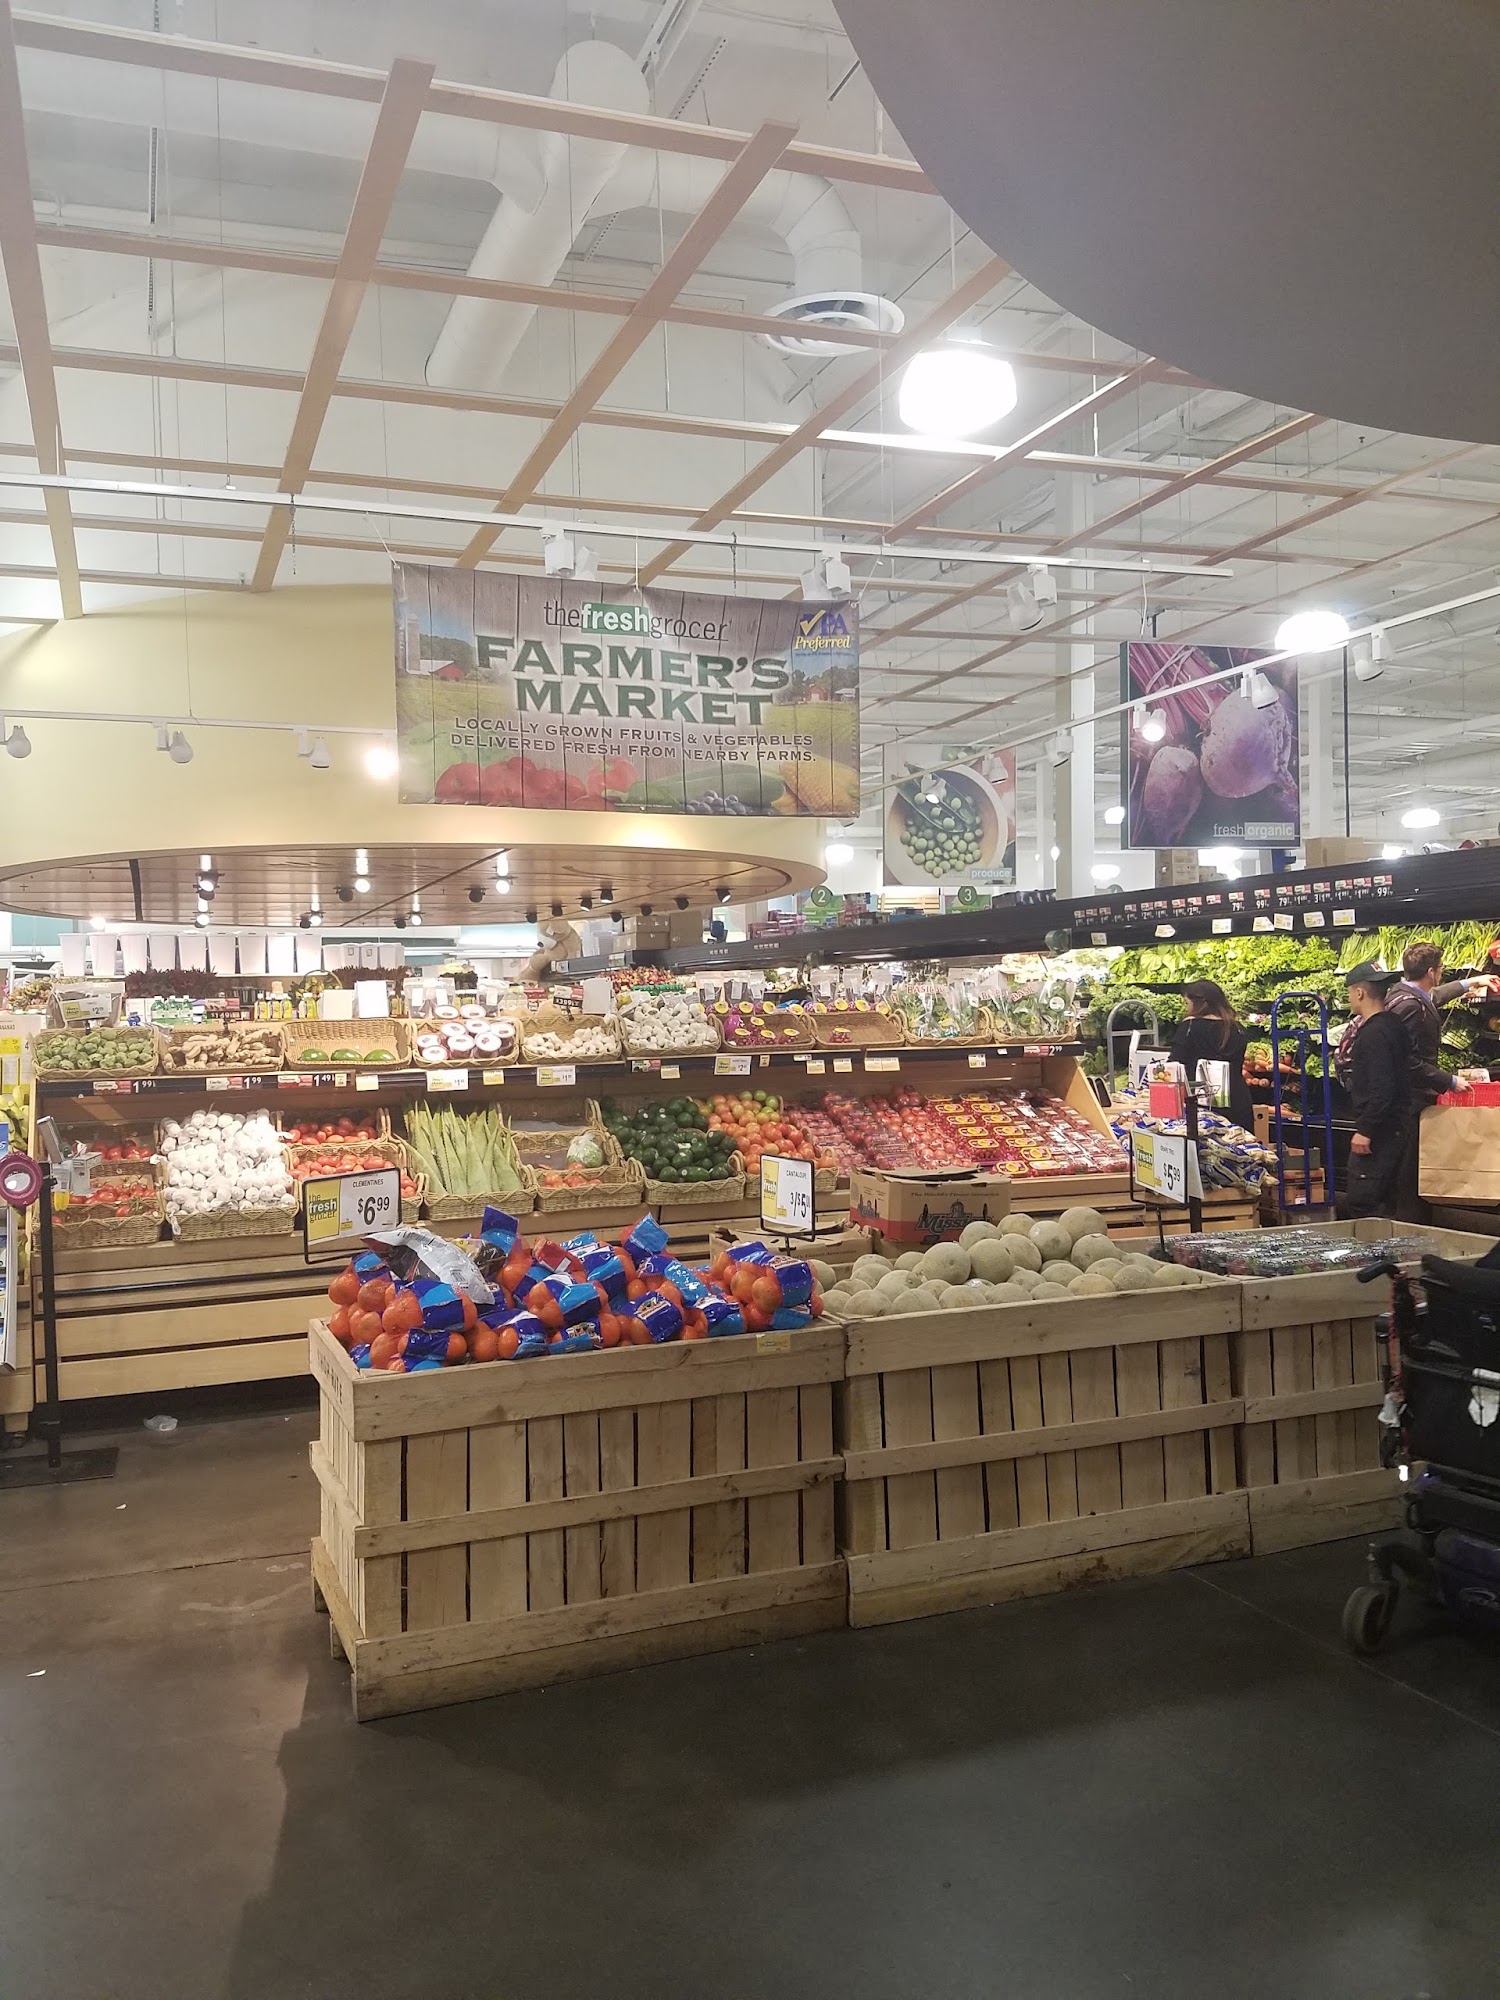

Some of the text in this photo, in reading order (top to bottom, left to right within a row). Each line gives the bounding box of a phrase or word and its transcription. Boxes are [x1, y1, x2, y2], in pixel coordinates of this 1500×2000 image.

[794, 636, 851, 652] Preferred
[476, 635, 789, 690] FARMER'S
[514, 678, 773, 725] MARKET
[455, 717, 813, 746] LOCALLY GROWN FRUITS & VEGETABLES
[451, 734, 816, 762] DELIVERED FRESH FROM NEARBY FARMS.
[971, 868, 1010, 879] produce
[817, 890, 826, 903] 2
[964, 888, 972, 903] 3
[352, 1178, 384, 1188] CLEMENTINES
[309, 1193, 321, 1202] the
[309, 1198, 337, 1214] fresh
